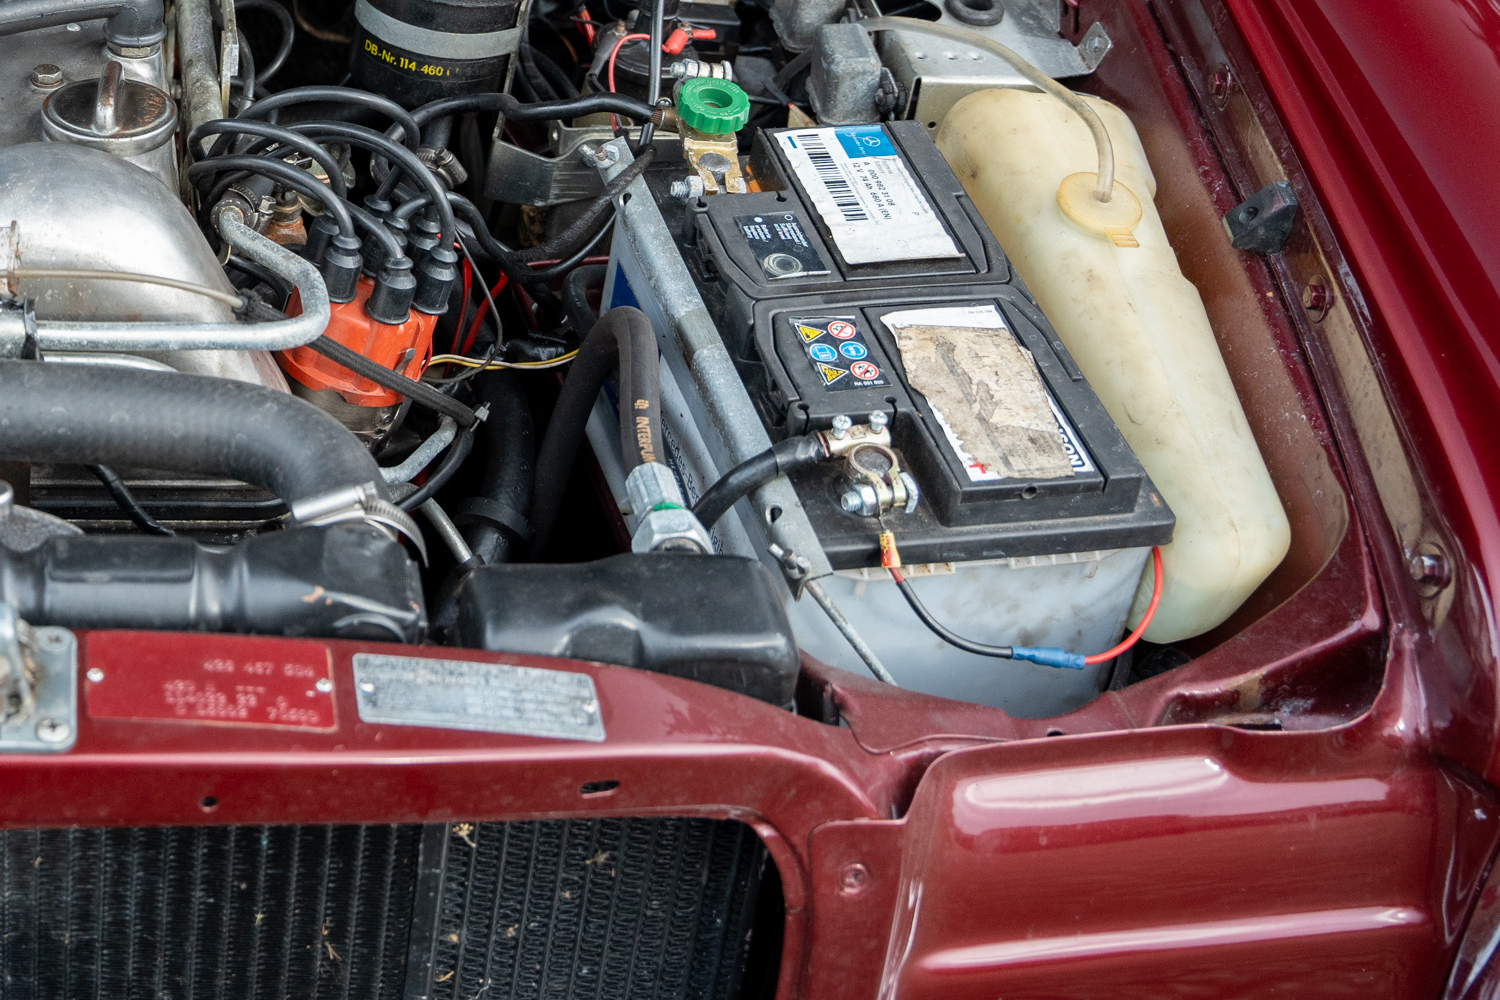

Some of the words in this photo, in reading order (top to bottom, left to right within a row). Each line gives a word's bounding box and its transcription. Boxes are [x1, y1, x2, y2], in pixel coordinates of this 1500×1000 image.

[364, 39, 397, 66] DB-Nr.
[399, 57, 416, 72] 114
[420, 64, 444, 77] 460
[636, 416, 656, 463] INTERPUM
[661, 413, 700, 503] ercedes-Ben
